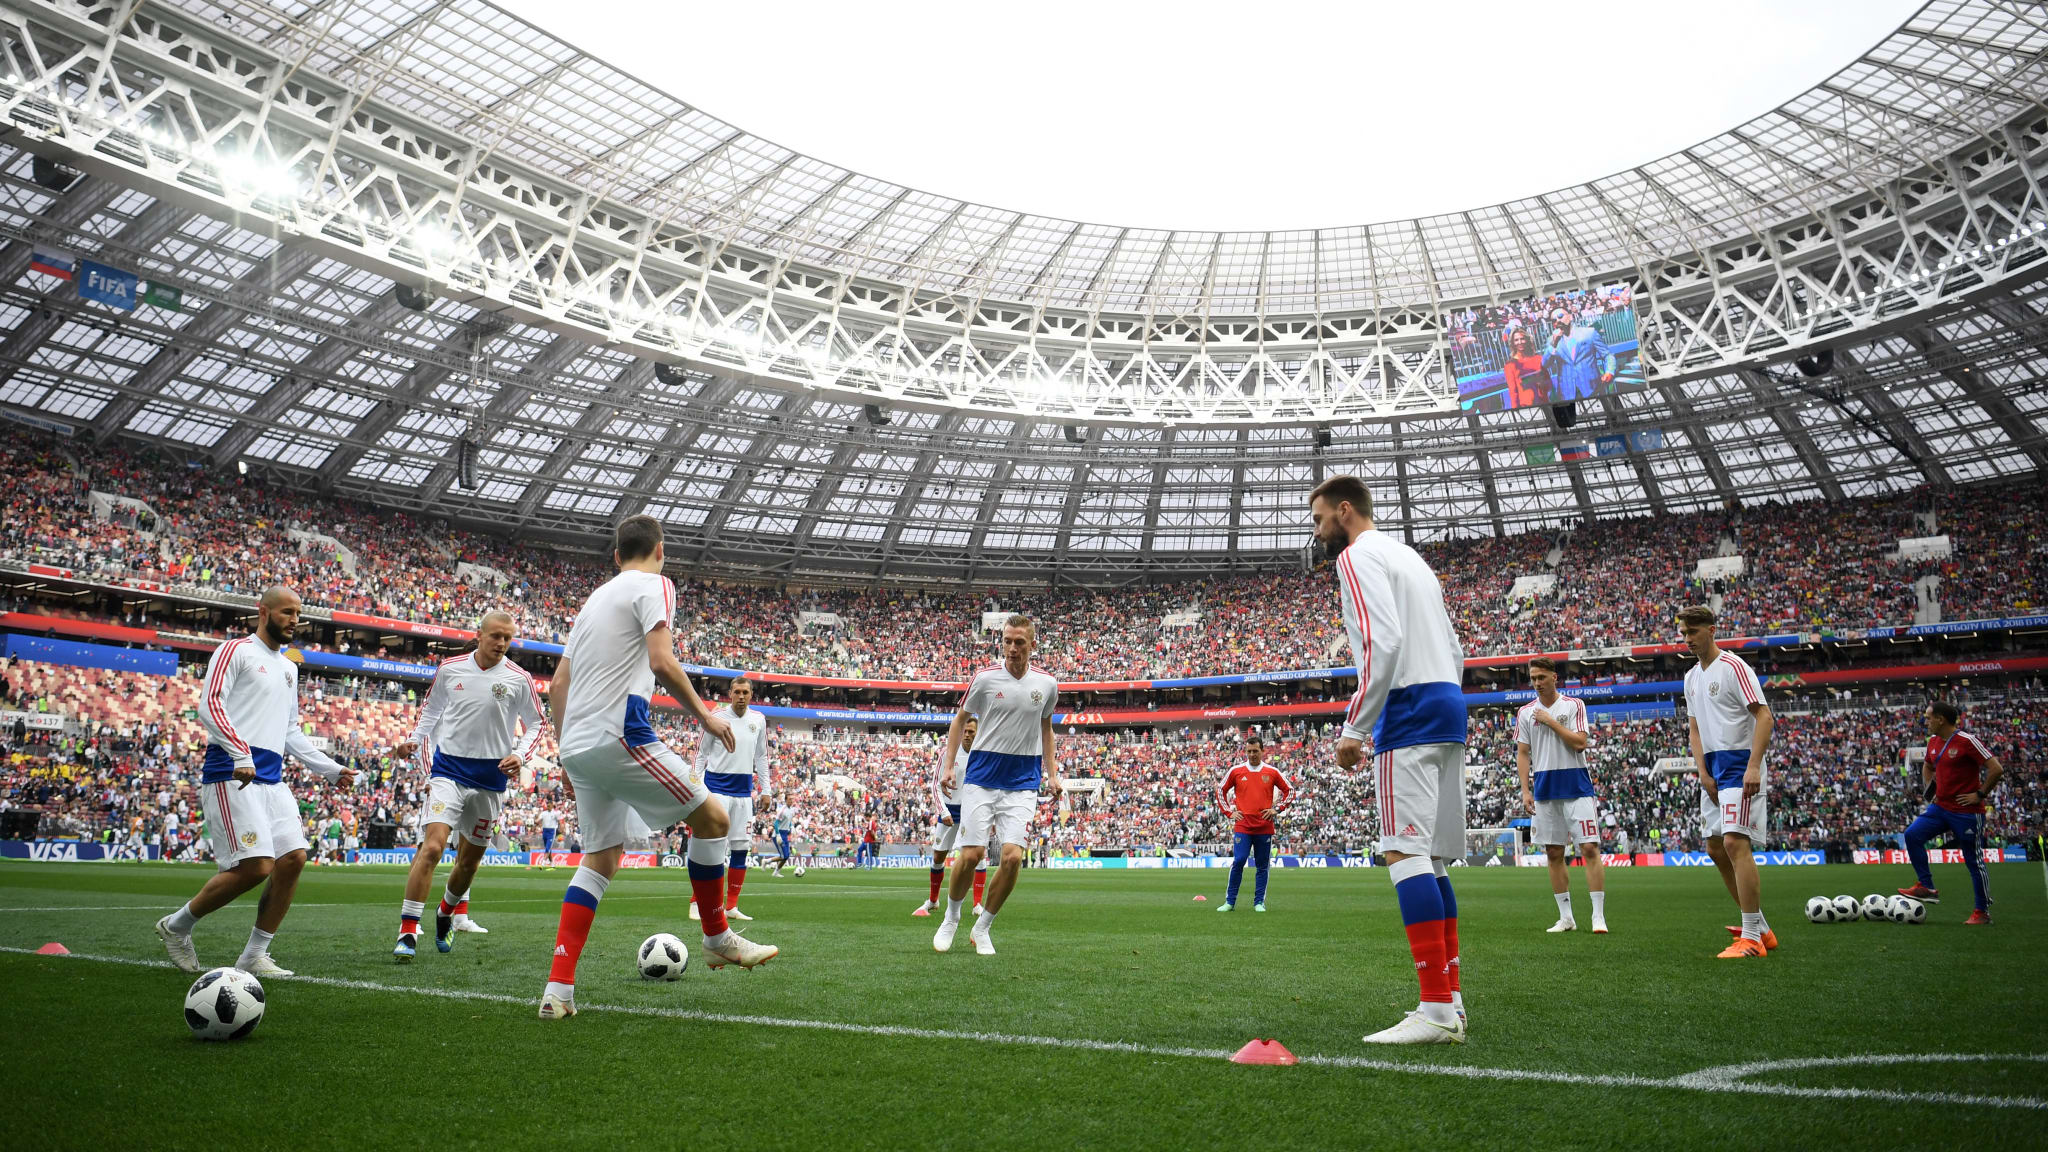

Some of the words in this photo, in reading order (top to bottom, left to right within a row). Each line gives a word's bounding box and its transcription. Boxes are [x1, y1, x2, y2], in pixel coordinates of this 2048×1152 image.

[88, 272, 127, 298] FIFA
[411, 625, 443, 636] MOSCOW
[1921, 626, 1934, 634] ПО
[1936, 623, 1979, 633] ФУТБОЛУ
[1981, 621, 2001, 630] FIFA
[2003, 619, 2025, 627] 2018
[362, 660, 379, 669] 2018
[379, 662, 395, 671] FIFA
[395, 664, 420, 674] WORLD
[1960, 662, 2002, 672] МОСКВА
[1243, 674, 1257, 682] 2018
[1257, 673, 1270, 681] FIFA
[1271, 672, 1293, 680] WORLD
[1294, 671, 1307, 679] CUP
[1308, 670, 1332, 678] RUSSIA
[1505, 692, 1522, 700] 2018
[1522, 691, 1537, 699] FIFA
[1583, 687, 1613, 696] RUSSIA
[816, 711, 856, 719] ЧЕМПИОНАТ
[1204, 708, 1236, 717] #worldcup
[1721, 803, 1737, 825] 15
[1579, 820, 1597, 837] 16
[26, 842, 78, 859] VISA
[358, 853, 384, 865] 2018
[386, 853, 410, 865] FIFA
[664, 856, 680, 865] KIA
[782, 857, 806, 869] ATAR
[808, 857, 848, 869] AIRWAYS
[877, 856, 898, 868] 万达
[899, 857, 931, 868] WANDA
[1168, 858, 1206, 868] GAZPROM
[1297, 857, 1328, 868] VISA
[1340, 857, 1371, 868] VISA
[1671, 852, 1716, 866] vivo
[1773, 851, 1820, 866] vivo
